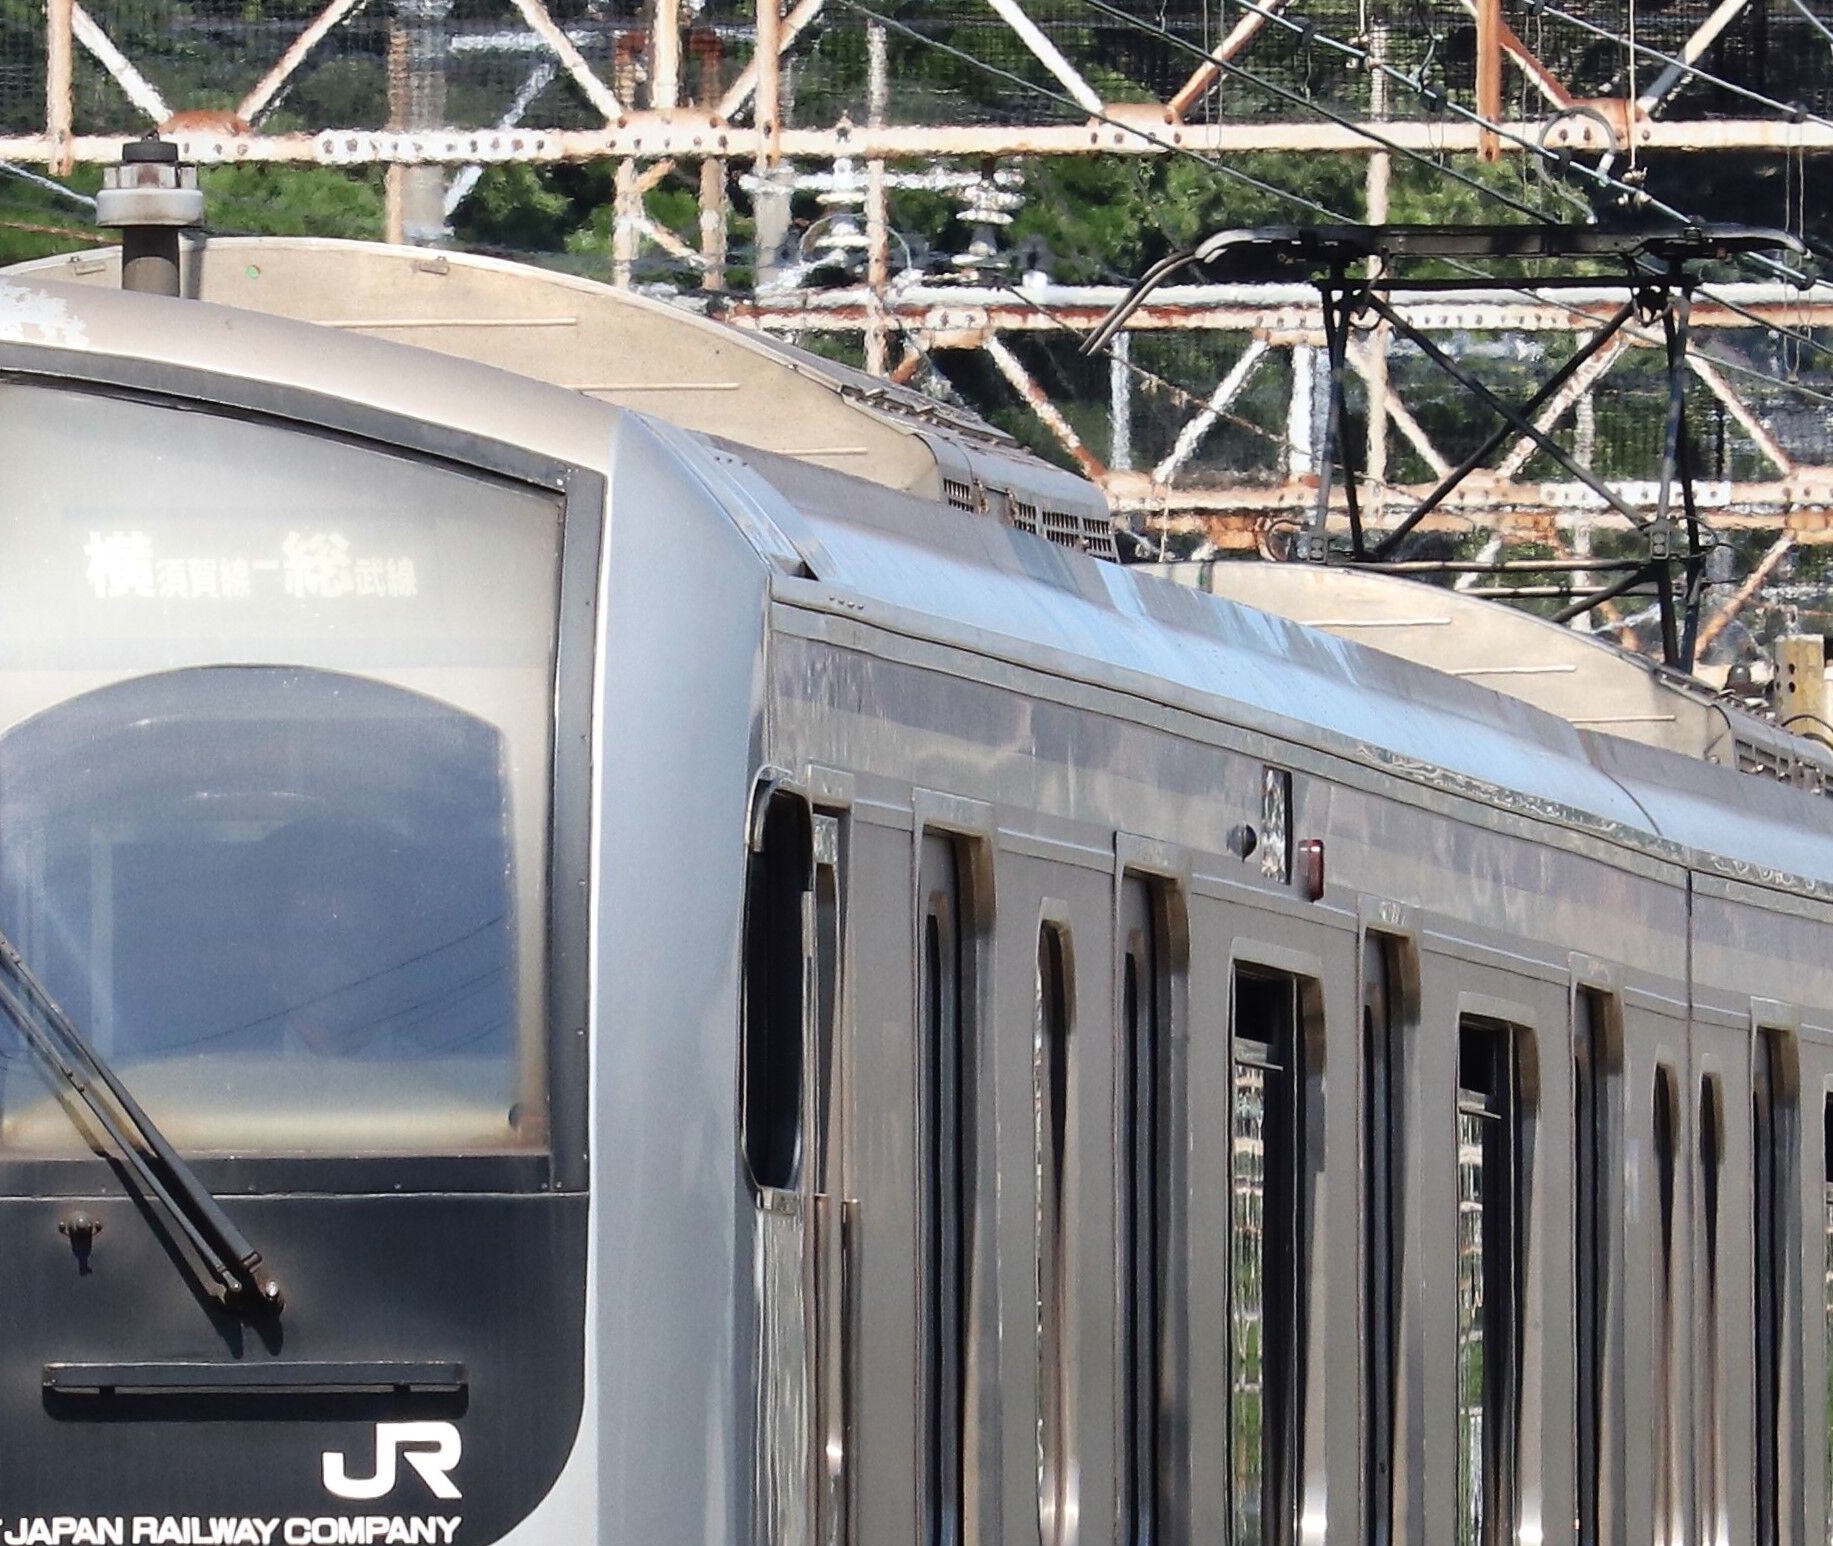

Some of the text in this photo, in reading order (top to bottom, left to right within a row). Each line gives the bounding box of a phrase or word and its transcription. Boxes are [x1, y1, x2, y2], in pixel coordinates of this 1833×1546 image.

[322, 1421, 463, 1499] JR
[3, 1516, 123, 1546] JAPAN
[132, 1516, 280, 1545] RAILWAY
[283, 1516, 462, 1545] COMPANY
